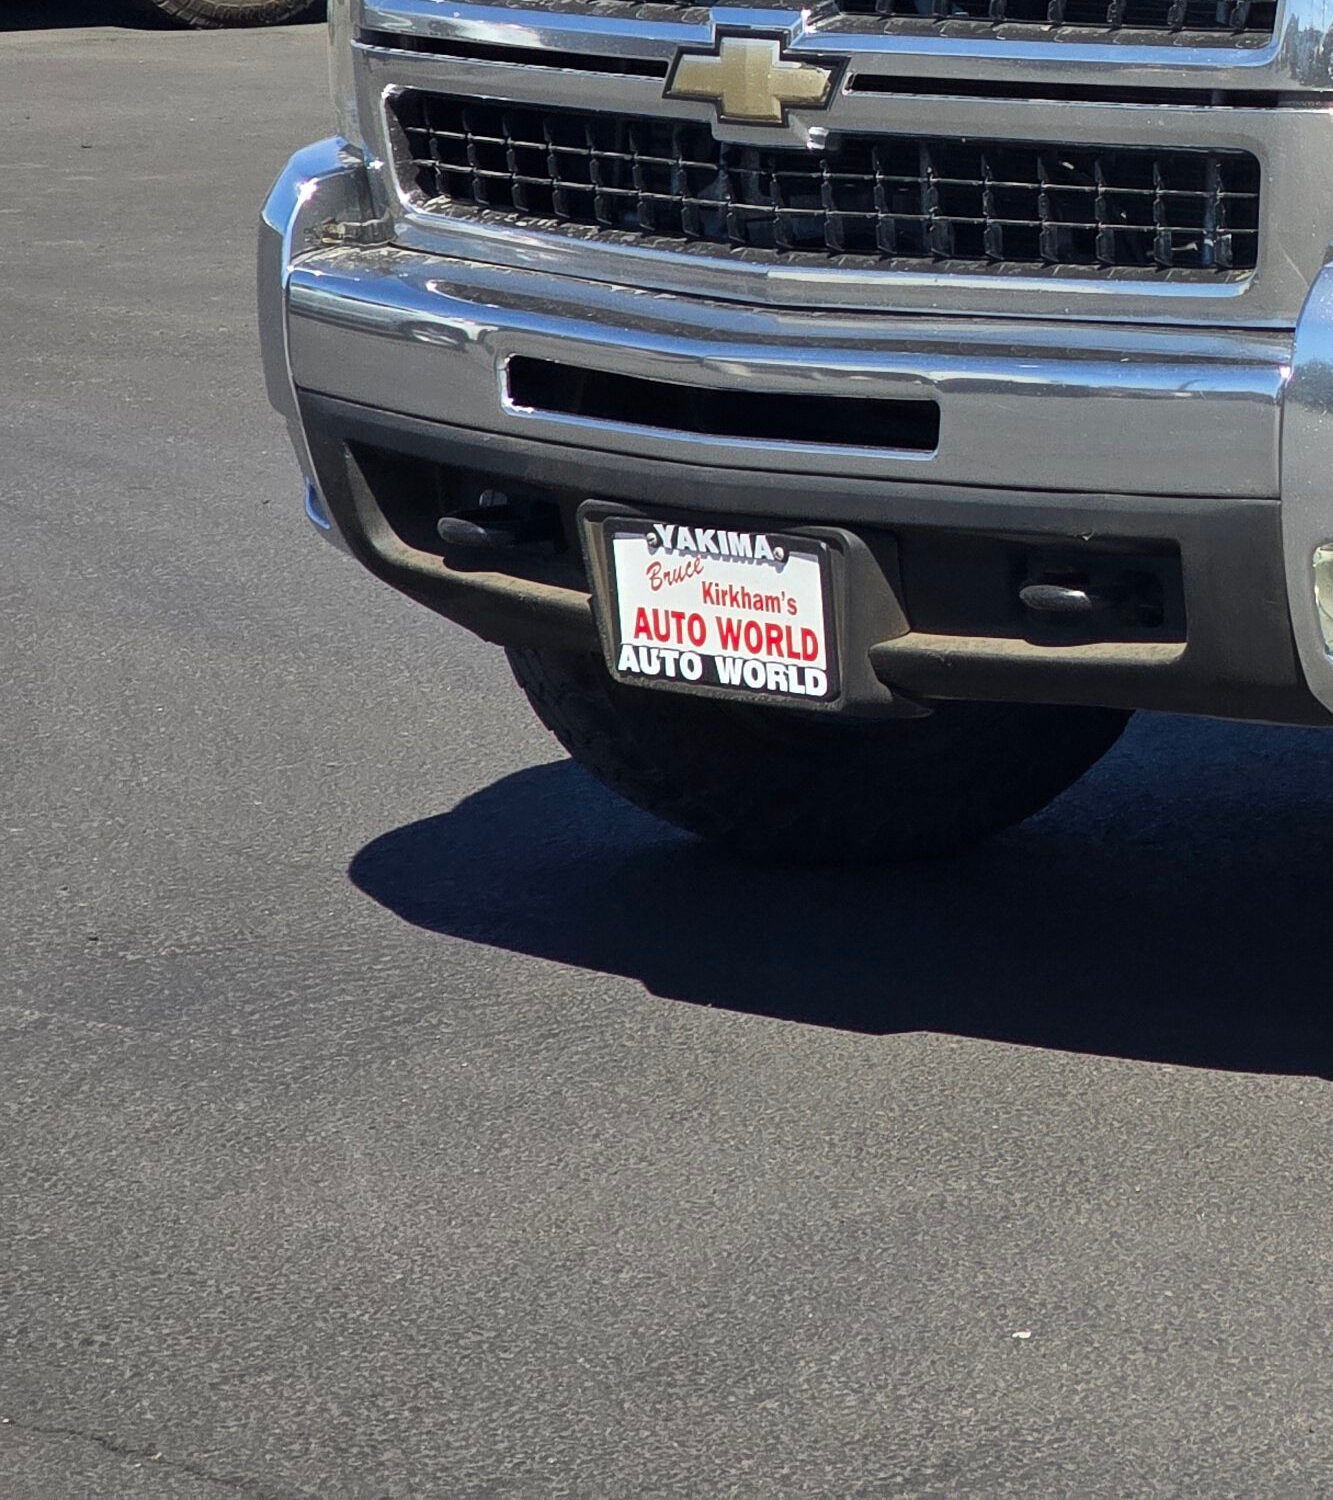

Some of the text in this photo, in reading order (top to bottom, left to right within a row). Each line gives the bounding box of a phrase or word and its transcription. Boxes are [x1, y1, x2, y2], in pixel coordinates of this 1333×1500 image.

[653, 523, 775, 561] YAKIMA
[646, 555, 705, 592] Bruce
[701, 580, 798, 617] Kirkham's
[633, 606, 820, 663] AUTO WORLD
[617, 644, 829, 698] AUTO WORLD
